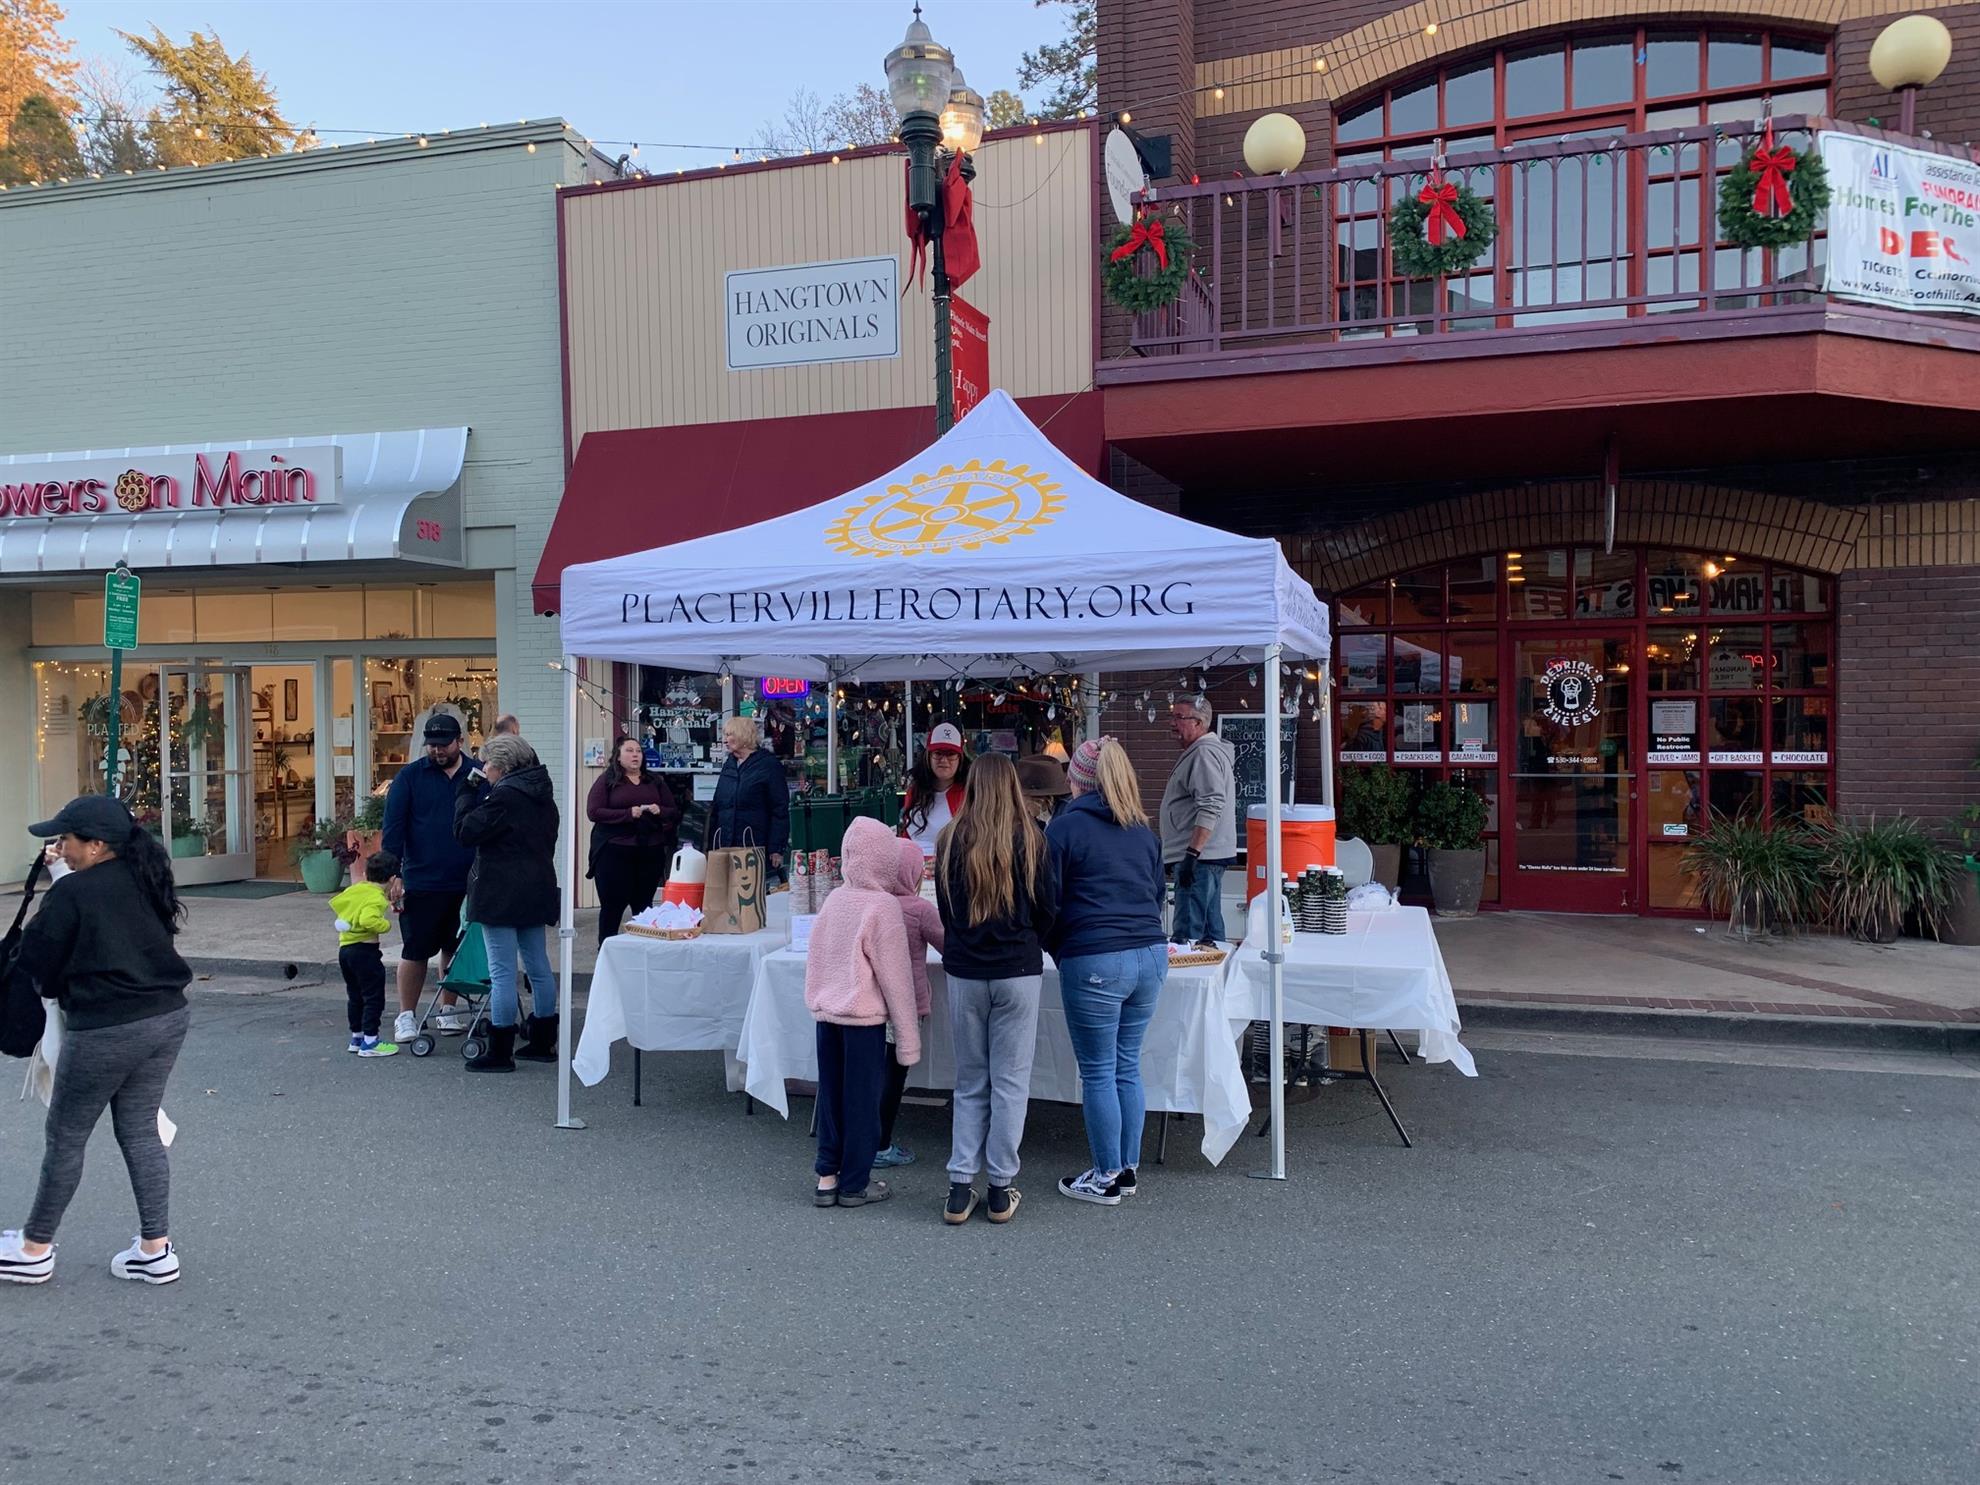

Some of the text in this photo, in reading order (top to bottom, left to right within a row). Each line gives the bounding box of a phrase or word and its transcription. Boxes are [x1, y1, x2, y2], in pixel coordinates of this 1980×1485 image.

[1926, 164, 1972, 186] assistance
[1904, 197, 1937, 218] For
[1942, 203, 1975, 228] The
[735, 278, 889, 315] HANGTOWN
[746, 313, 879, 348] ORIGINALS
[0, 478, 106, 517] wers
[192, 451, 316, 506] Main
[621, 582, 1195, 623] PLACERVILLEROTARY.ORG
[1540, 660, 1604, 685] DEDRICK'S
[765, 677, 804, 694] OPEN
[1543, 706, 1600, 726] CHEESE
[87, 723, 139, 736] PLATED
[1368, 753, 1385, 761] EGGS
[1400, 753, 1435, 761] CRACKERS
[1451, 753, 1496, 761] SALAMI NUTS
[1714, 754, 1761, 762] GIFT BASKETS
[1780, 754, 1825, 762] CHOCOLATE
